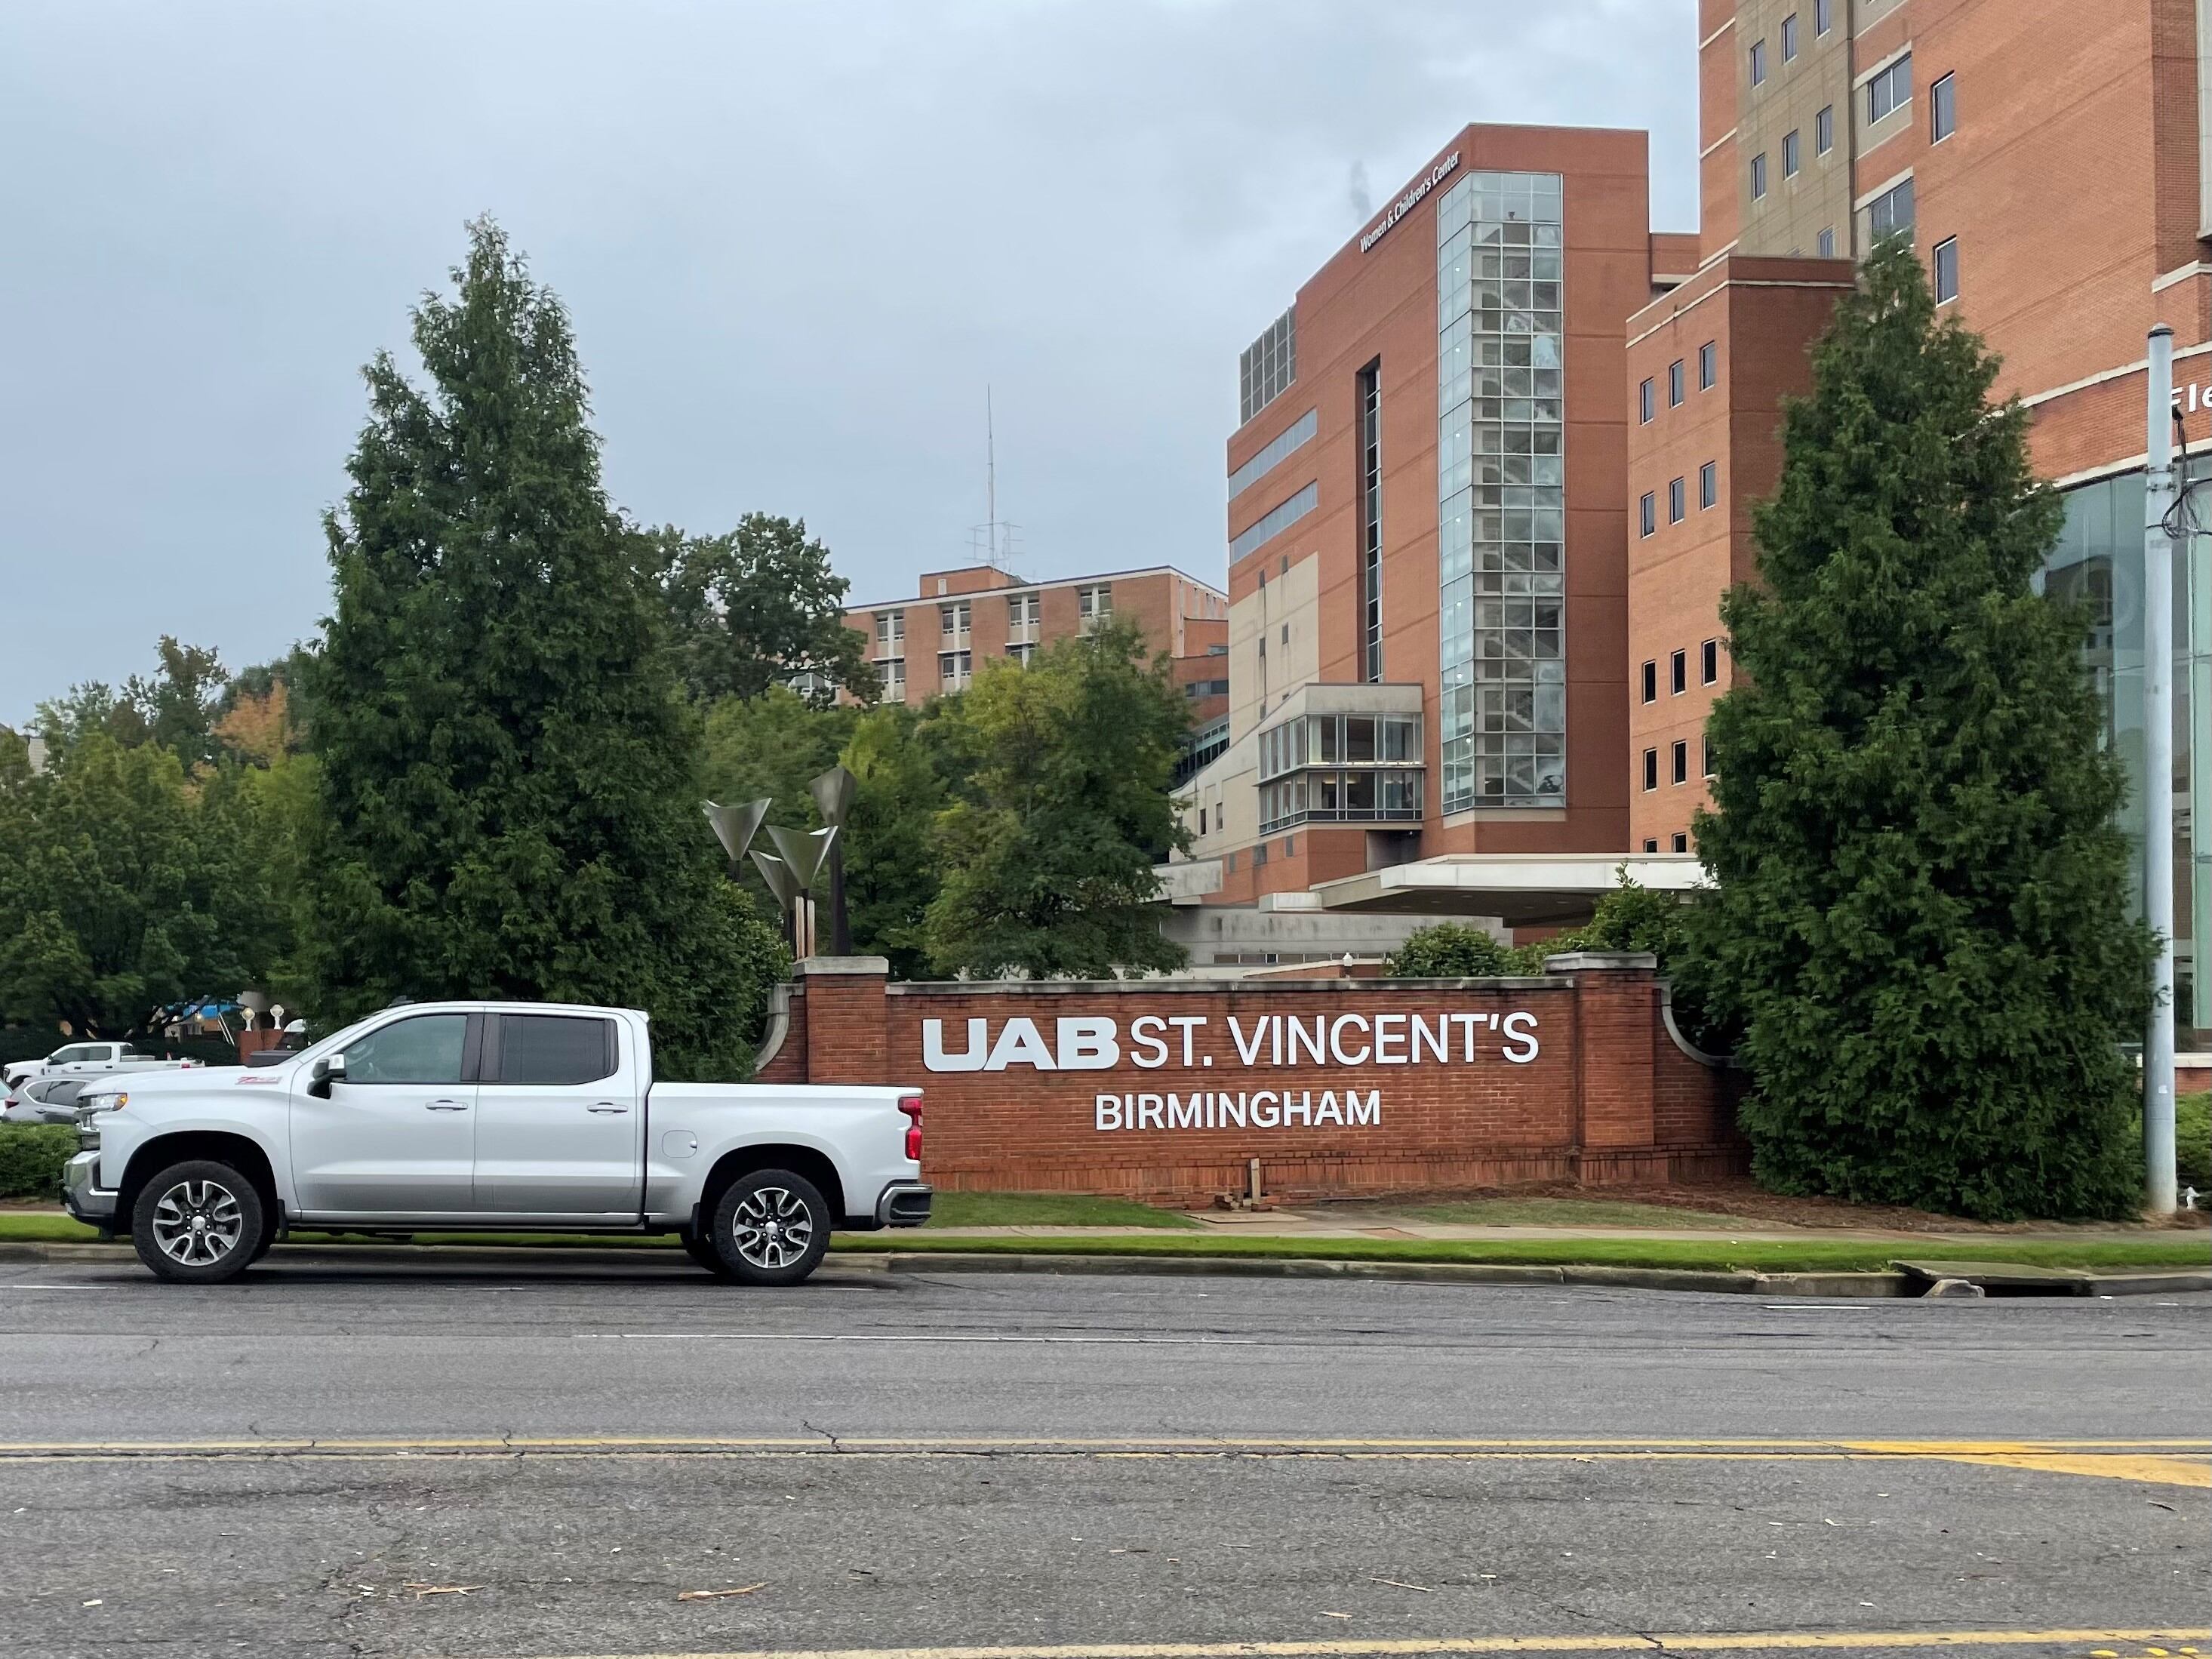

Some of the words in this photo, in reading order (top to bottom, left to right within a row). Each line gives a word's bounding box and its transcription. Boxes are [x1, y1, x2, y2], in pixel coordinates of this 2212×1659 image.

[1360, 220, 1387, 253] Women
[1387, 210, 1395, 228] &
[1395, 177, 1432, 221] Children's
[1432, 151, 1460, 186] Center
[922, 1016, 1120, 1072] UAB
[1130, 1015, 1213, 1068] ST.
[1226, 1011, 1539, 1066] VINCENT'S
[1096, 1089, 1380, 1131] BIRMINGHAM
